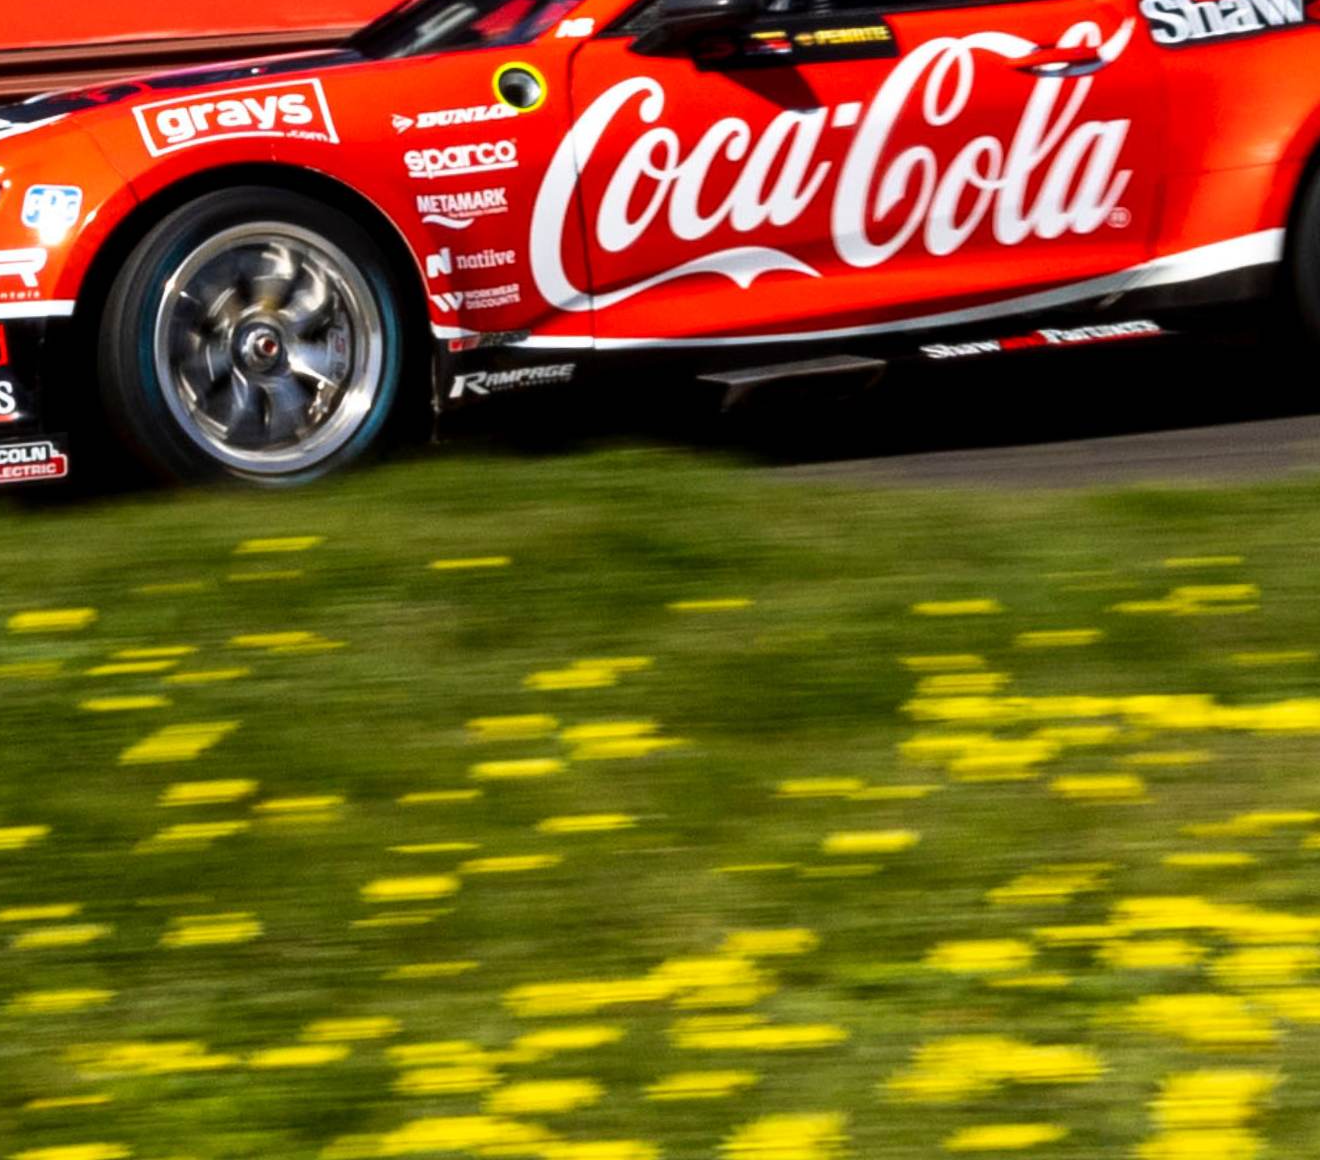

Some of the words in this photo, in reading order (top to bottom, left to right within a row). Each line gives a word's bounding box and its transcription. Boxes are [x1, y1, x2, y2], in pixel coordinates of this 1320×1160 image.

[156, 93, 313, 144] grays
[403, 139, 517, 178] sparco
[529, 17, 1135, 312] Coca-Cola
[416, 186, 508, 214] METAMARK
[456, 249, 516, 270] natiive
[448, 363, 576, 399] RAMPAGE
